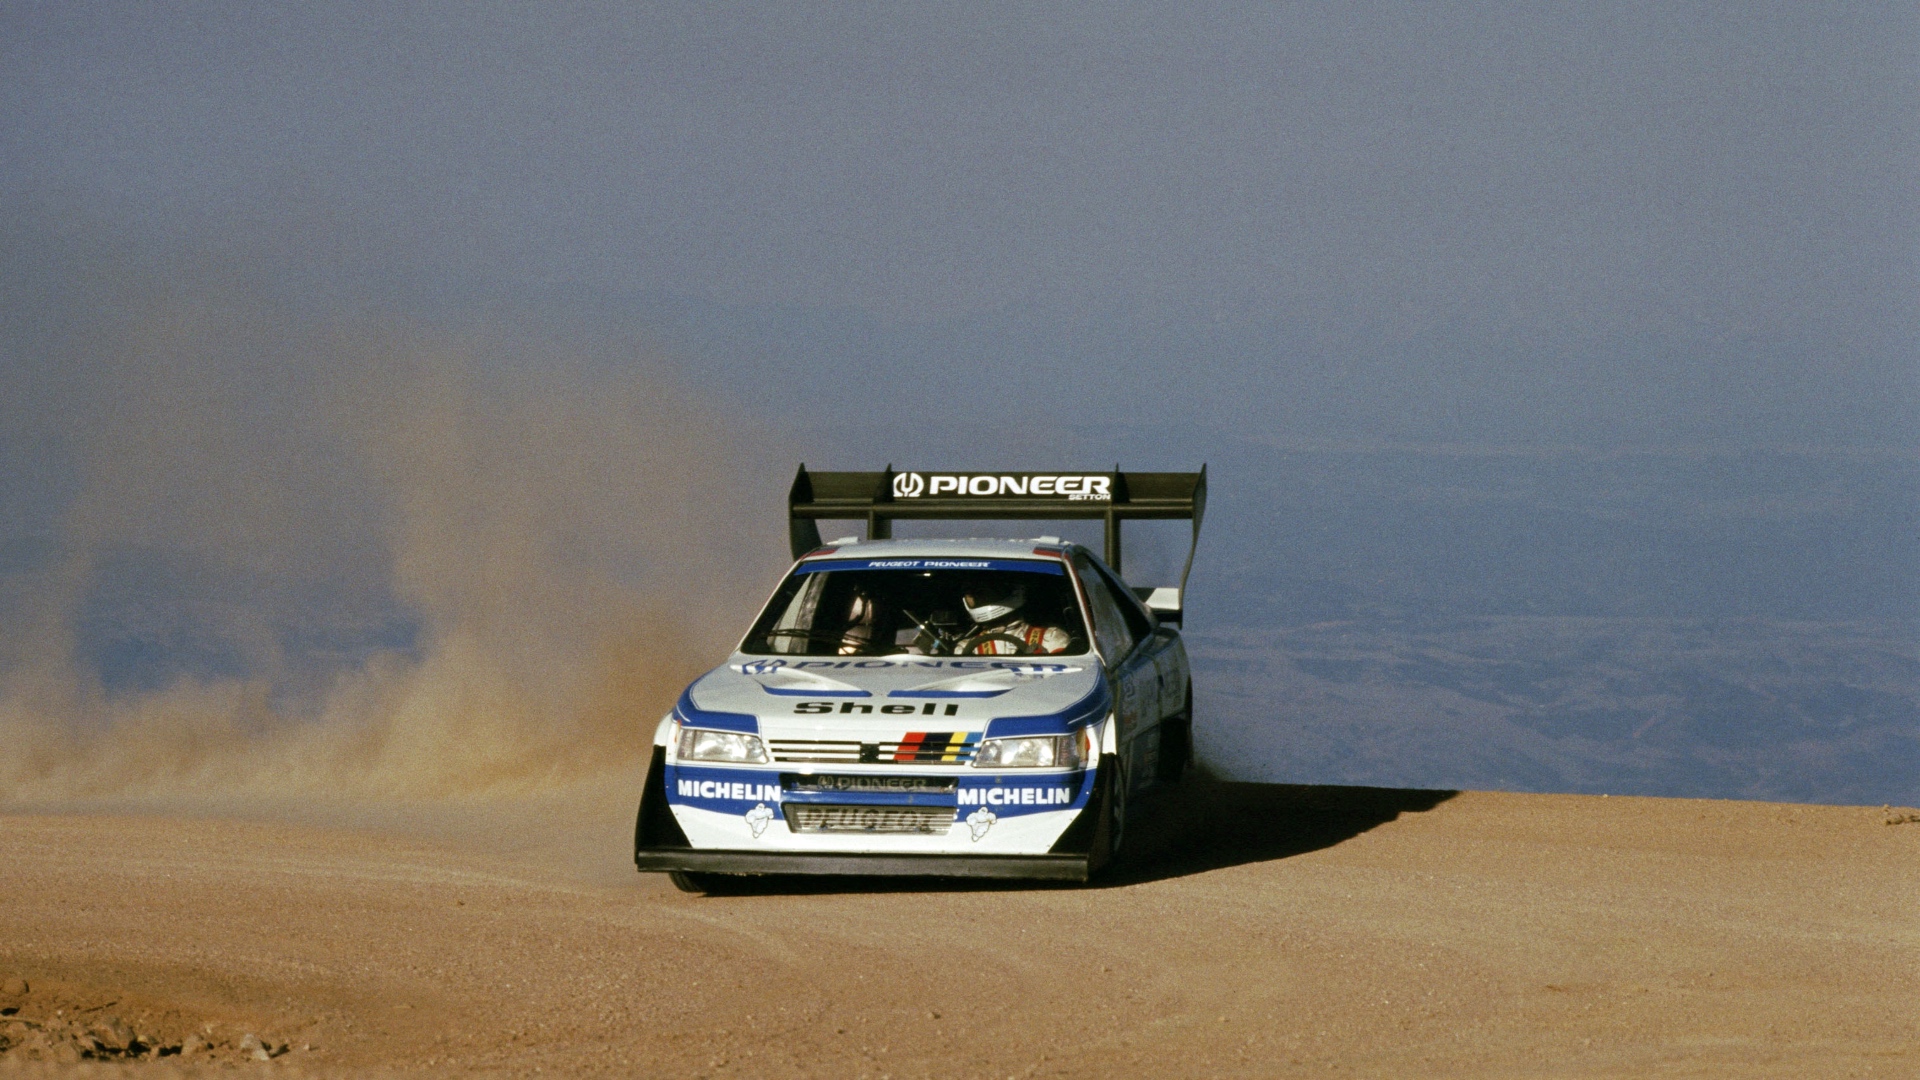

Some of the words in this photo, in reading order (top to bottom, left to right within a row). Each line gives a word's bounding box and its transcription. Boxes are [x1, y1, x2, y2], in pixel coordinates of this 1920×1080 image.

[929, 476, 1111, 495] PIONEER
[1068, 493, 1111, 501] SETTON
[793, 701, 959, 716] Shell
[677, 779, 781, 802] MICHELIN
[957, 787, 1070, 805] MICHELIN
